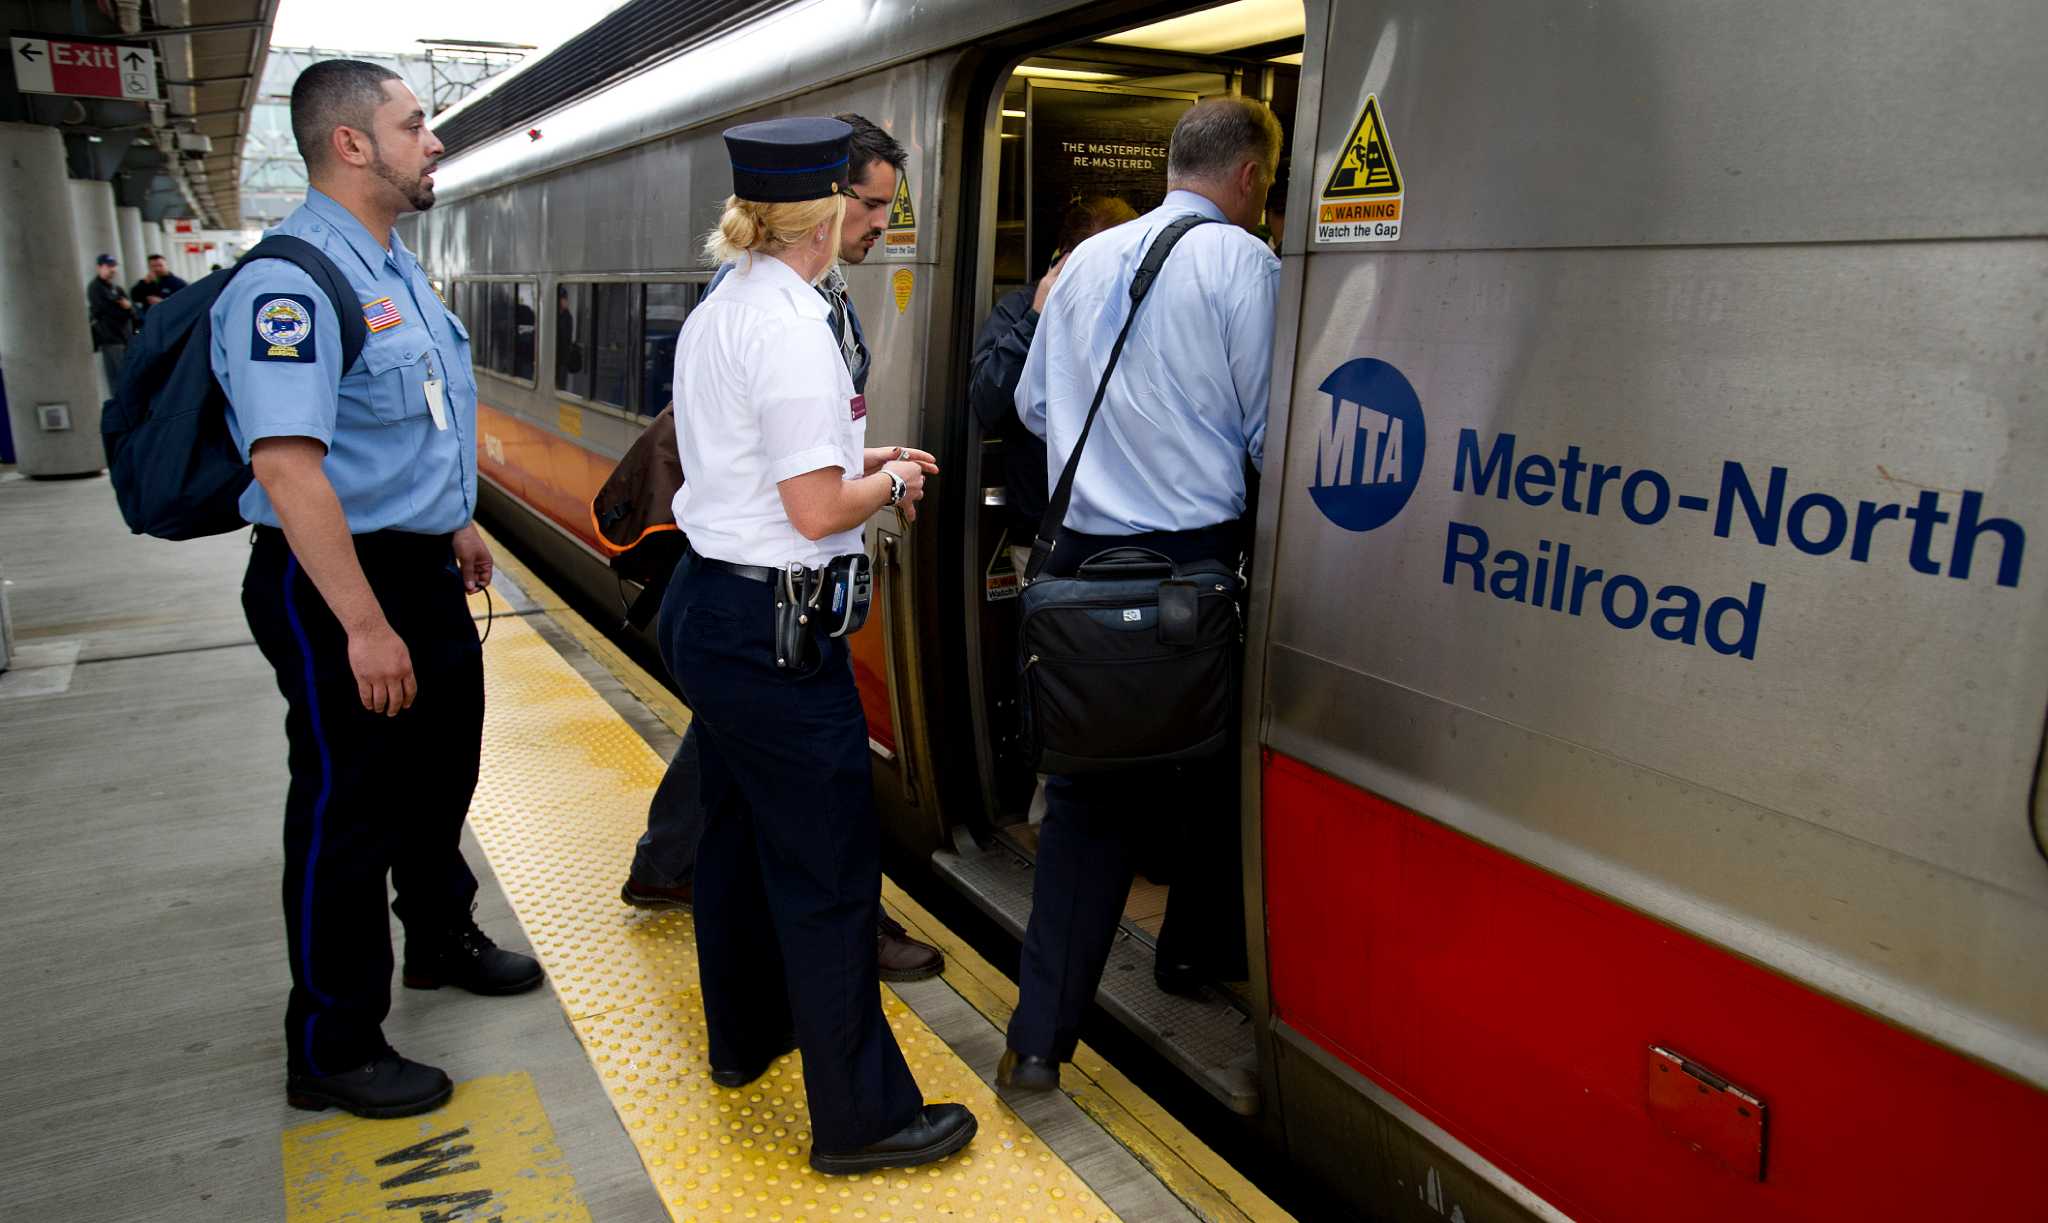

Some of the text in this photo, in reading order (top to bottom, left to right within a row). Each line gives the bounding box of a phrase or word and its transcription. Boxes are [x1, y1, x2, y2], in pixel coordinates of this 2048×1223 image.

[51, 42, 116, 69] Exit
[1062, 142, 1166, 158] THE MASTERPIECE
[1336, 204, 1395, 219] WARNING
[1319, 223, 1398, 238] Watch the Gap
[1306, 399, 1403, 487] MTA
[1453, 428, 2026, 588] Metro-North
[1442, 521, 1766, 660] Railroad
